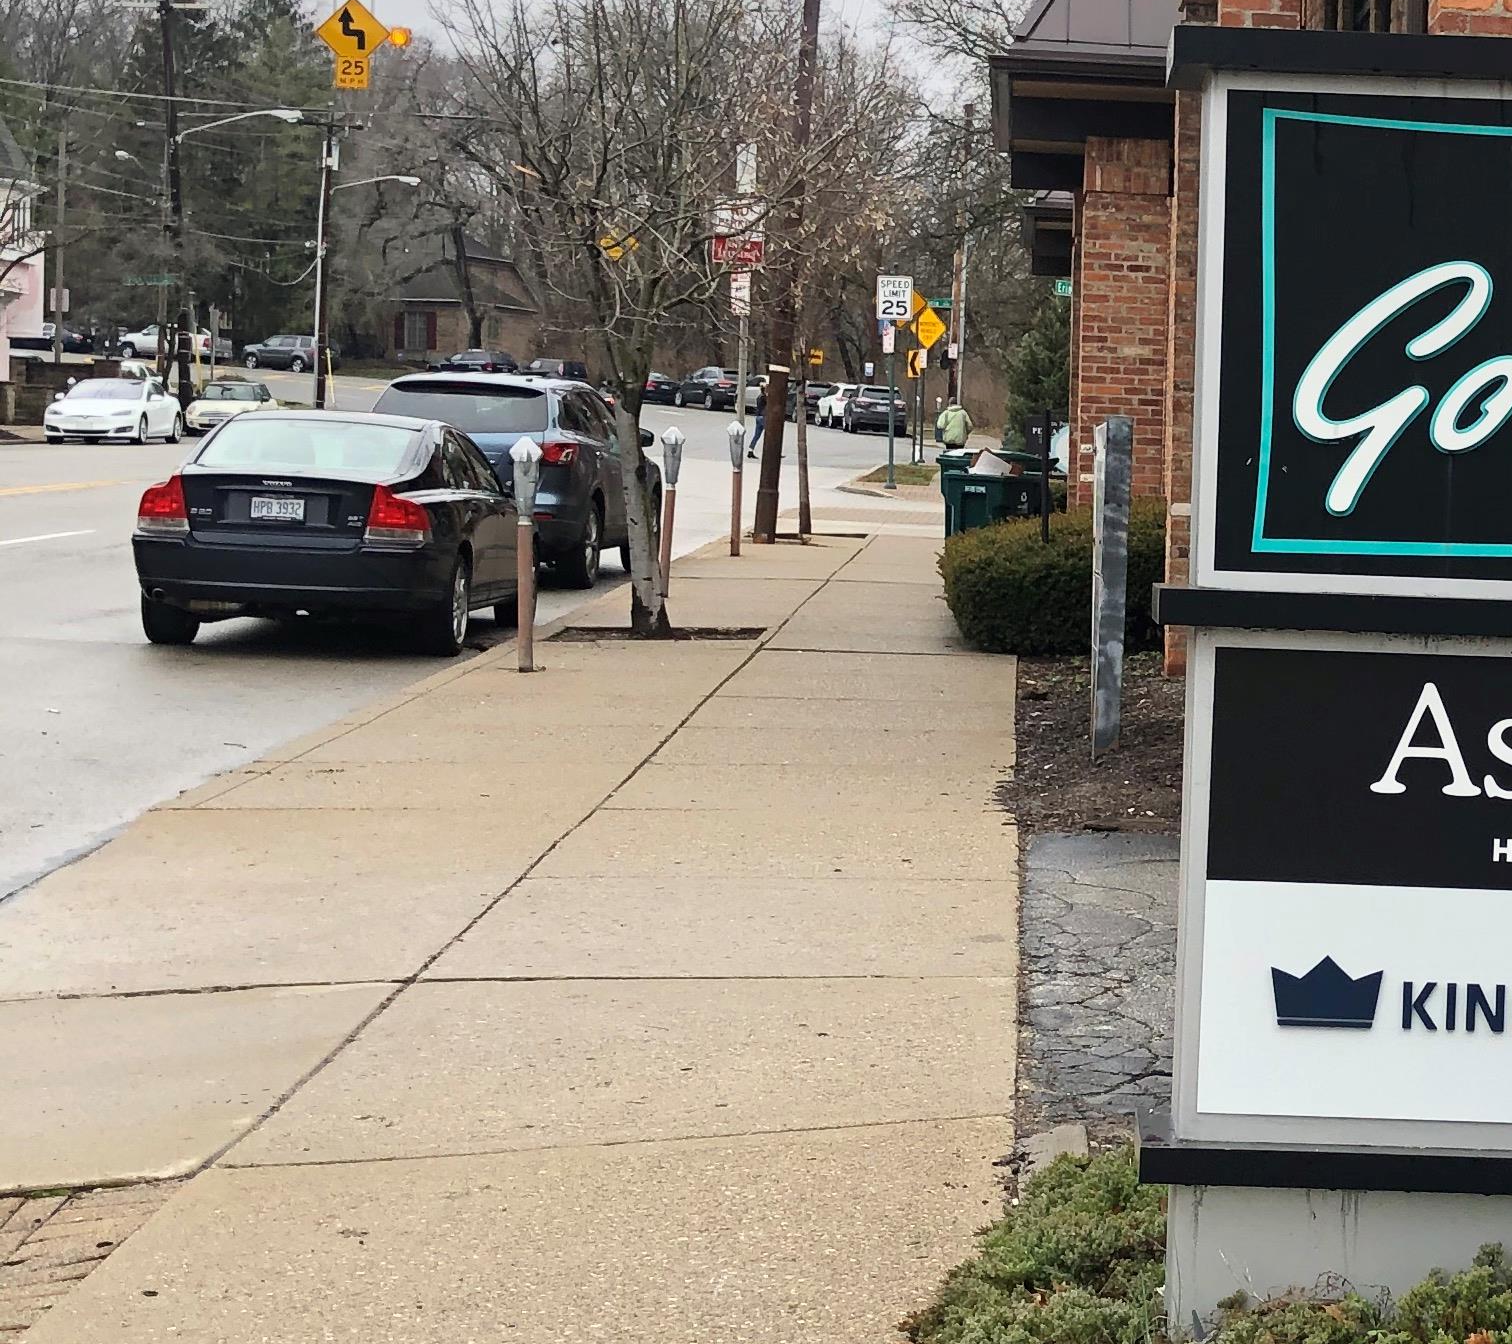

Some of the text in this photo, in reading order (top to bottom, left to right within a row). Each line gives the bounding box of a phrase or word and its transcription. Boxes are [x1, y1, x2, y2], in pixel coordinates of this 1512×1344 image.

[341, 60, 364, 76] 25
[880, 280, 910, 289] SPEED
[883, 289, 906, 298] LIMIT
[882, 300, 908, 316] 25
